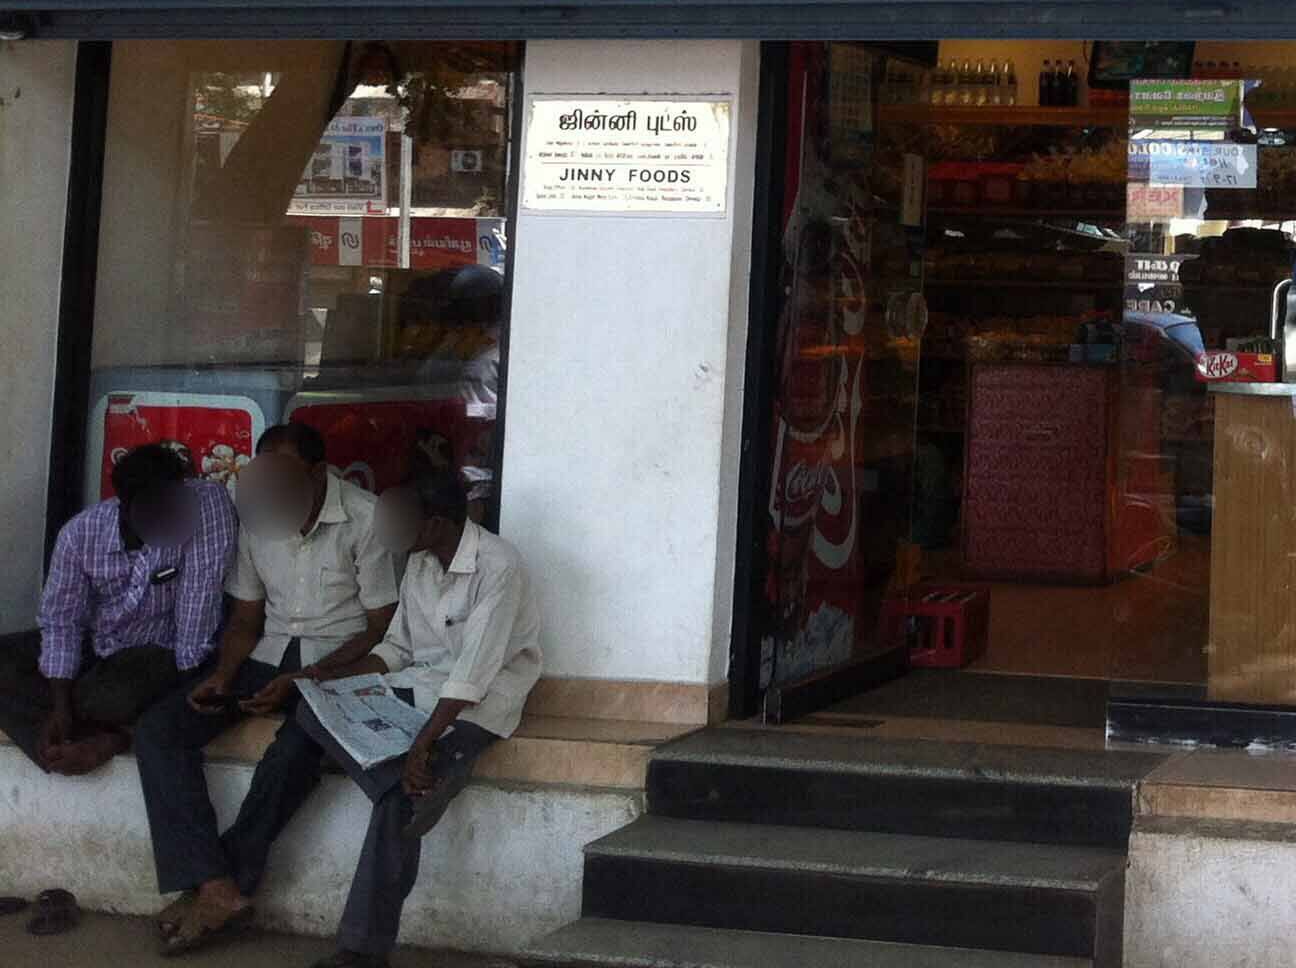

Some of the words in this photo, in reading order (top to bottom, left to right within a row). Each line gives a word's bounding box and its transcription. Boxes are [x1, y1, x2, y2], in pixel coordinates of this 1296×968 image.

[559, 108, 637, 131] ஜின்னி
[647, 109, 697, 136] புட்ஸ்
[559, 168, 616, 182] JINNY
[629, 168, 691, 183] FOODS
